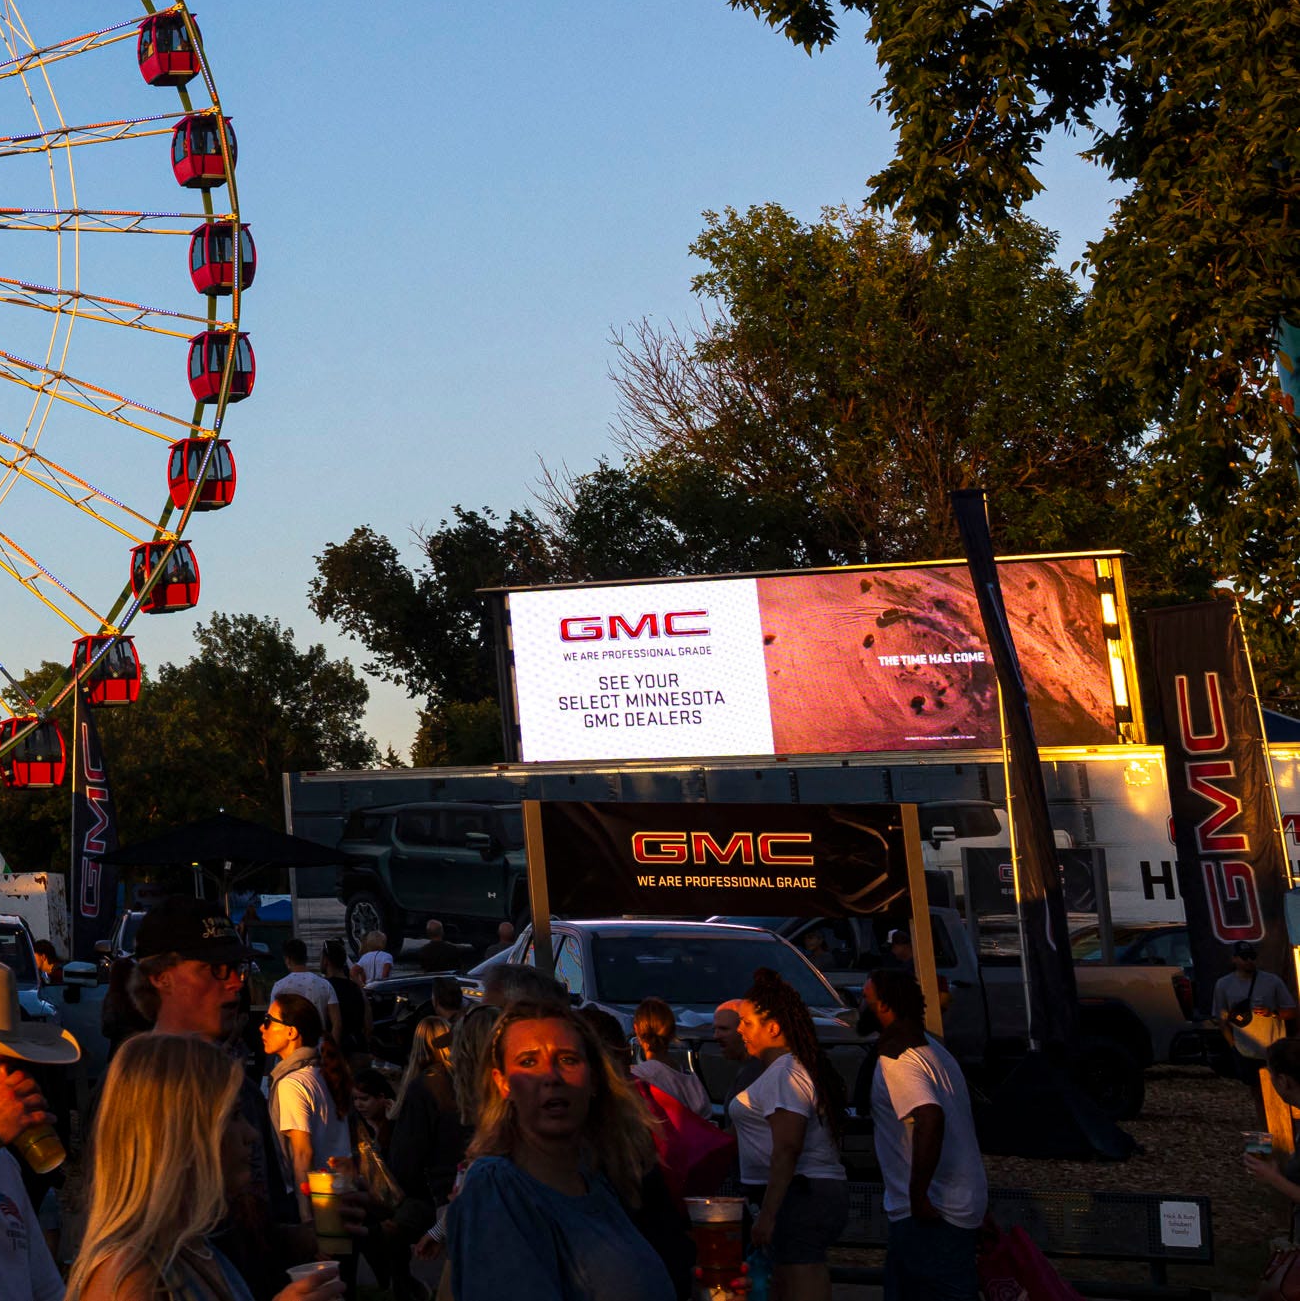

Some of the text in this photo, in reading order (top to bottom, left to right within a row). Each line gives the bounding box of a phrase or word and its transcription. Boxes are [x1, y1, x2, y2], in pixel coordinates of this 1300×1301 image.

[559, 609, 711, 643] GMC
[563, 645, 712, 662] WE ARE PROFESSIONAL GRADE
[878, 652, 985, 667] THE TIME HAS COME
[599, 673, 679, 690] SEE YOUR
[559, 690, 725, 711] SELECT MINNESOTA
[584, 710, 702, 728] GMC DEALERS
[1175, 672, 1265, 944] GMC
[80, 722, 109, 918] GMC
[632, 831, 814, 866] GMC
[637, 875, 816, 888] WE ARE PROFESSIONAL GRADE
